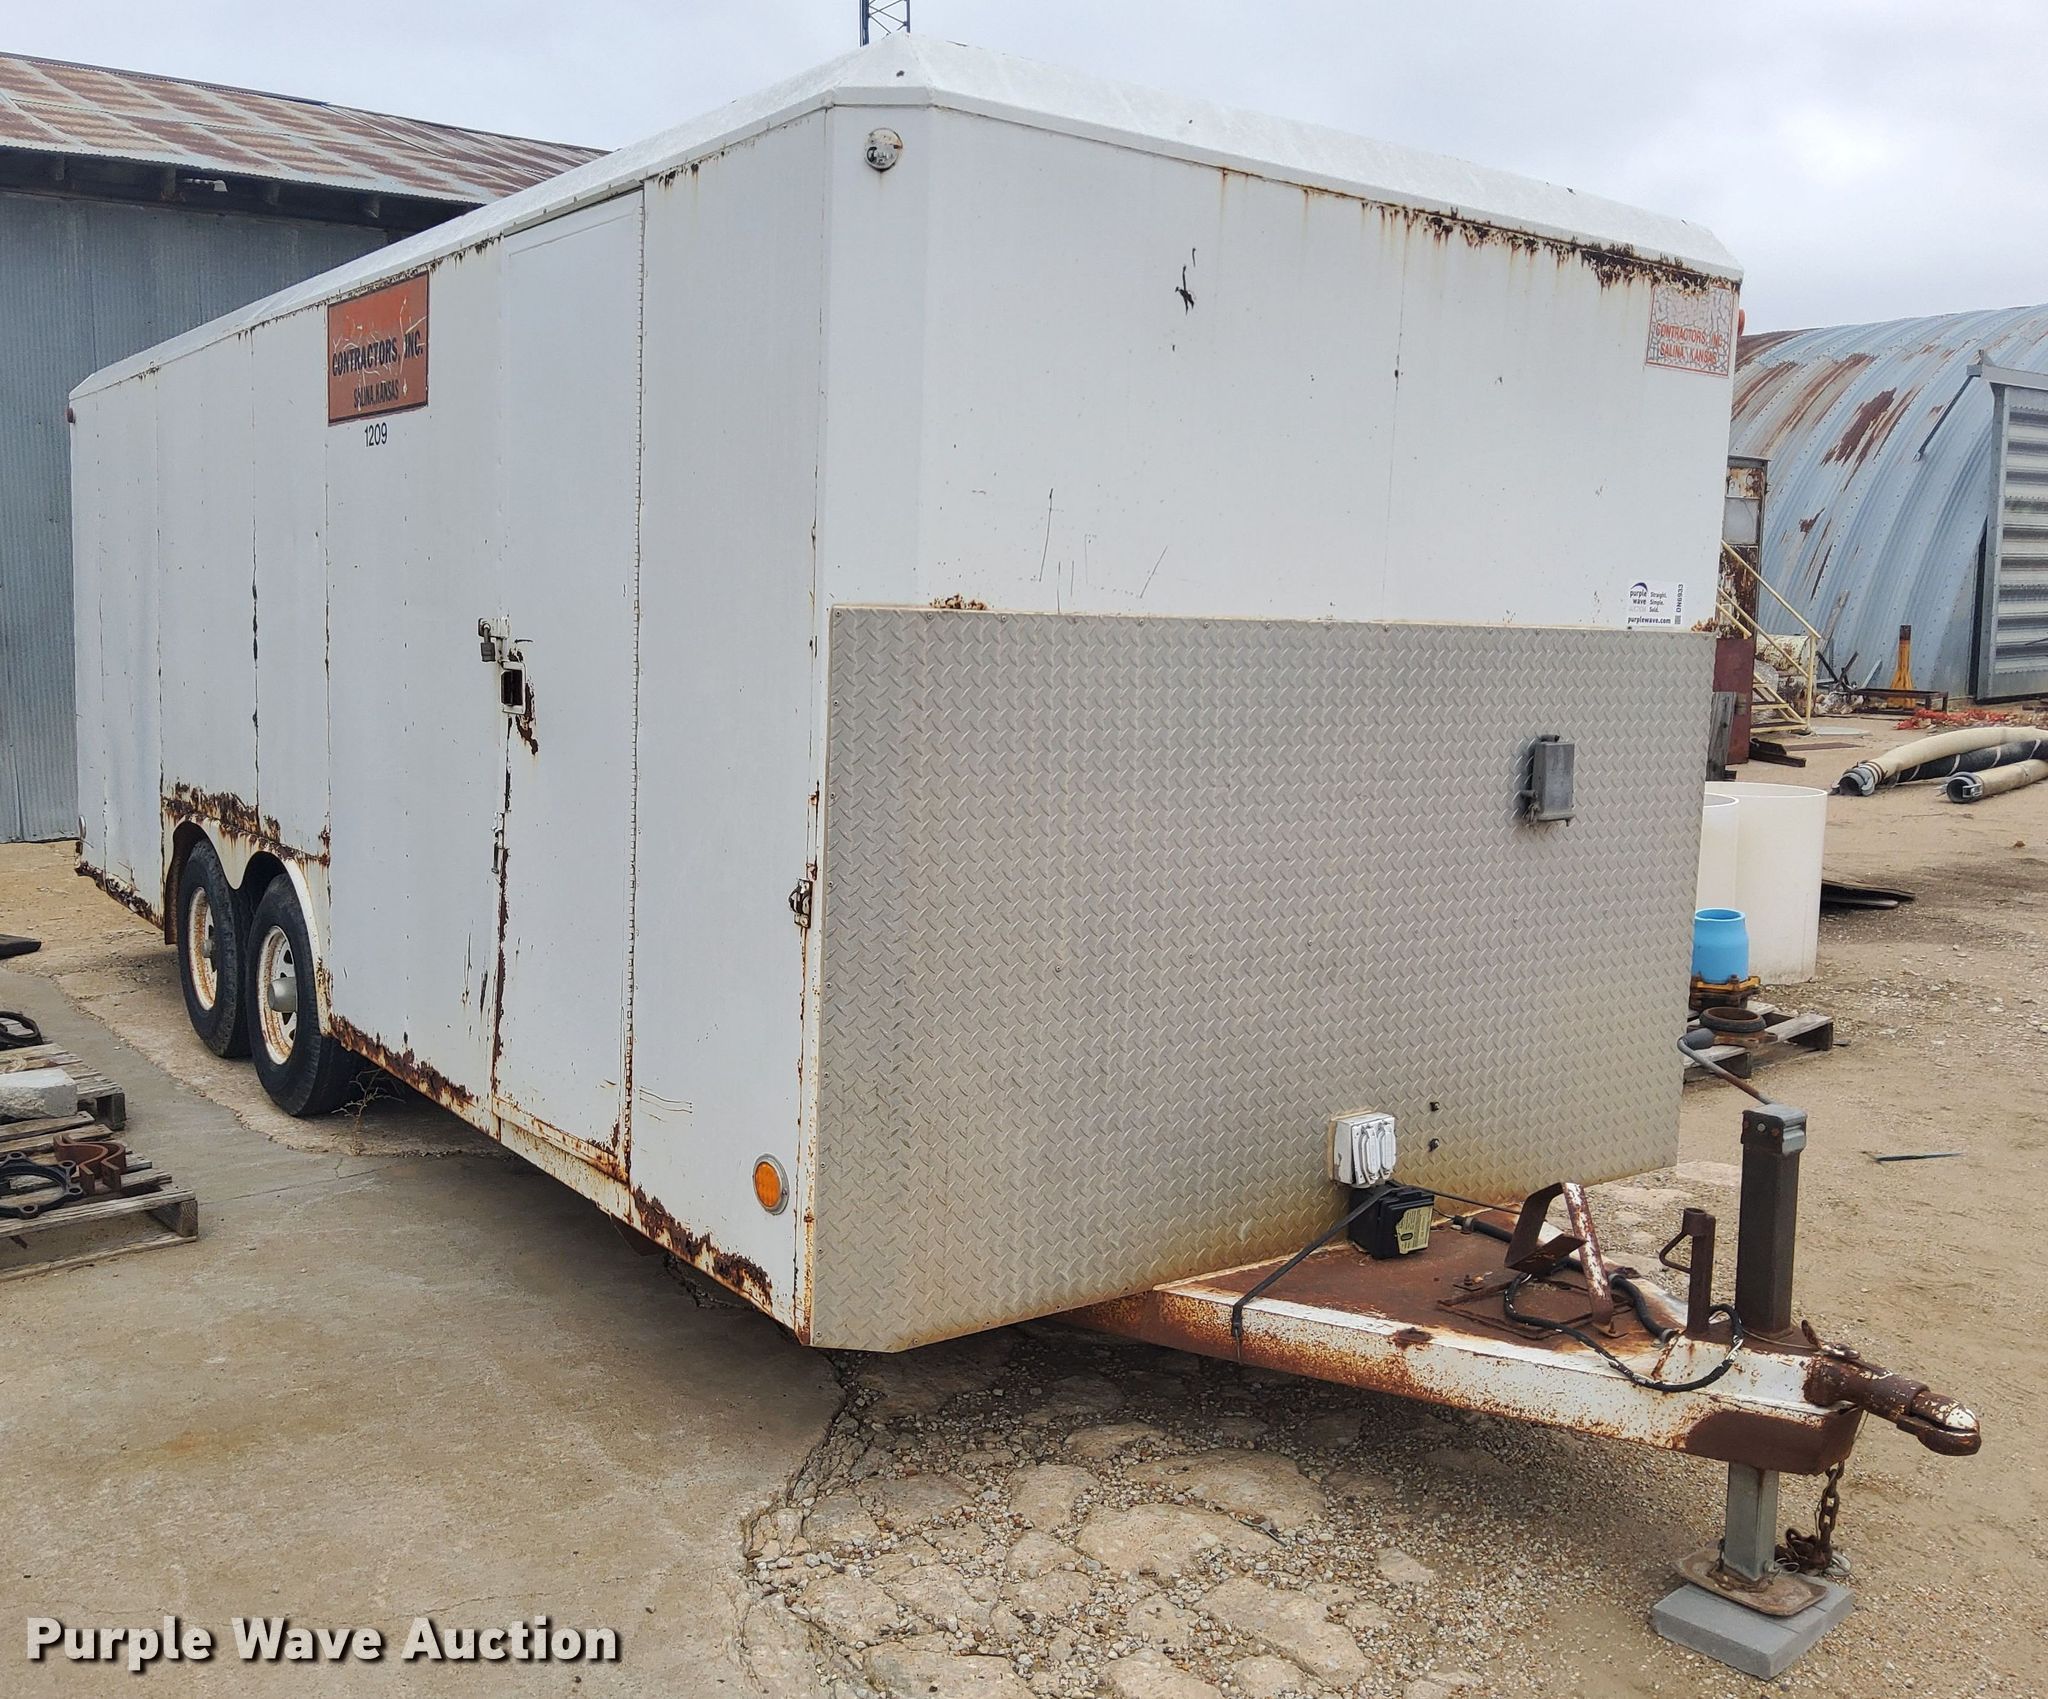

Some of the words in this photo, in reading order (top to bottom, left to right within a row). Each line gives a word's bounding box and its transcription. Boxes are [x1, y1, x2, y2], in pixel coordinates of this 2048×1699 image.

[403, 330, 423, 359] INC.
[365, 422, 388, 447] 1209
[1630, 589, 1647, 598] purple
[1628, 616, 1671, 624] purplewave.com
